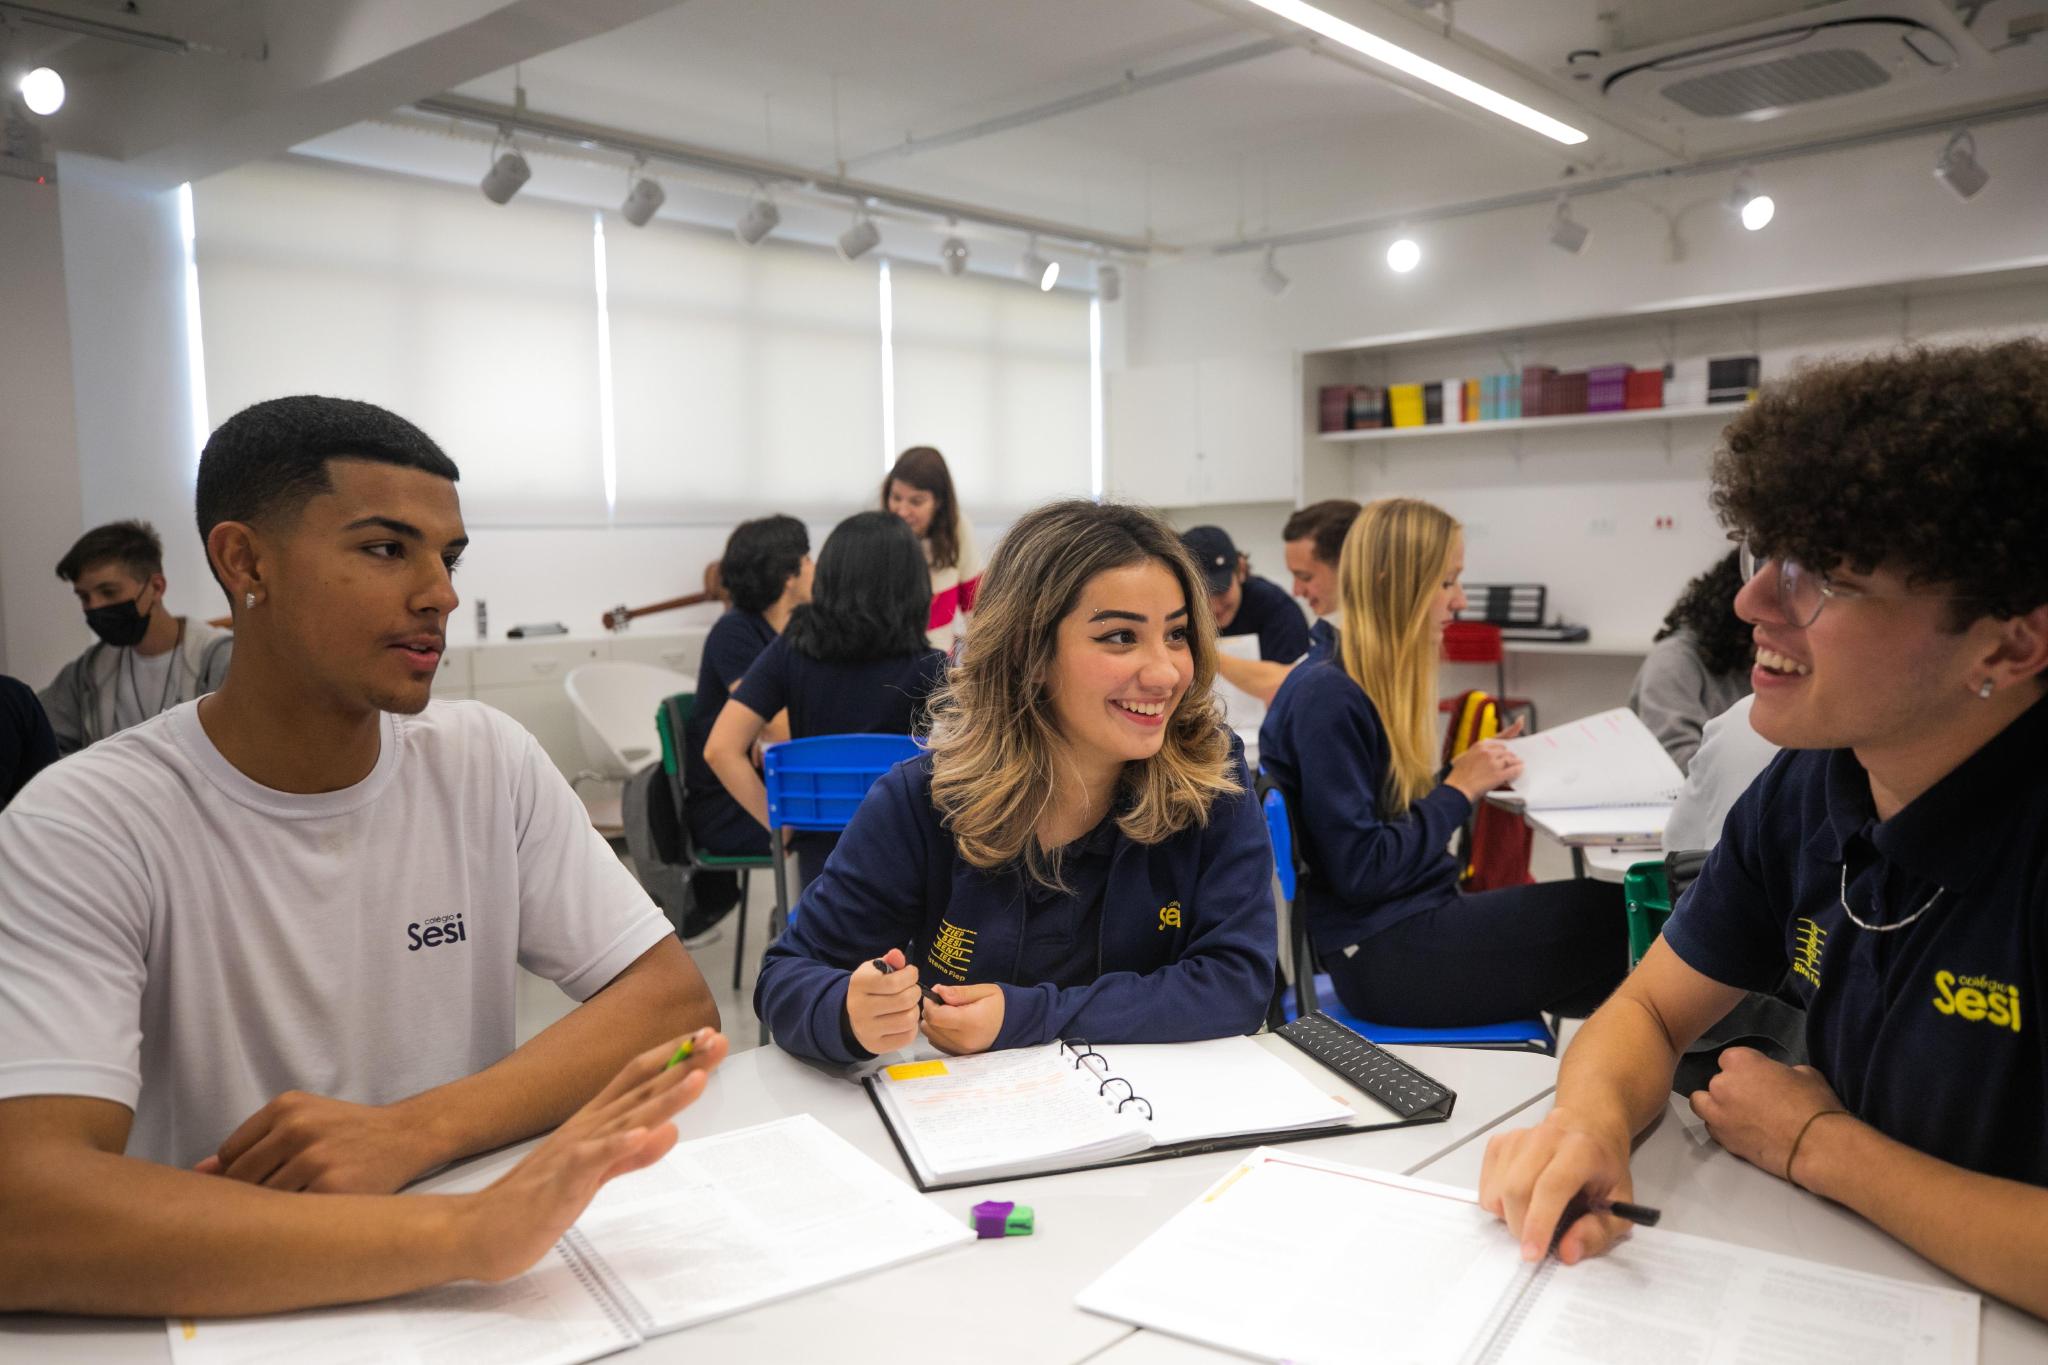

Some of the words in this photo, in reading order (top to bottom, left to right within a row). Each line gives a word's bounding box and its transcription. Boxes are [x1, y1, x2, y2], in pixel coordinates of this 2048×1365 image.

[407, 912, 467, 951] Sesi
[945, 926, 965, 938] FIEP
[936, 940, 964, 958] SENAI
[941, 934, 963, 948] SESI
[939, 952, 952, 964] IEL
[1933, 970, 2021, 1032] Sesi
